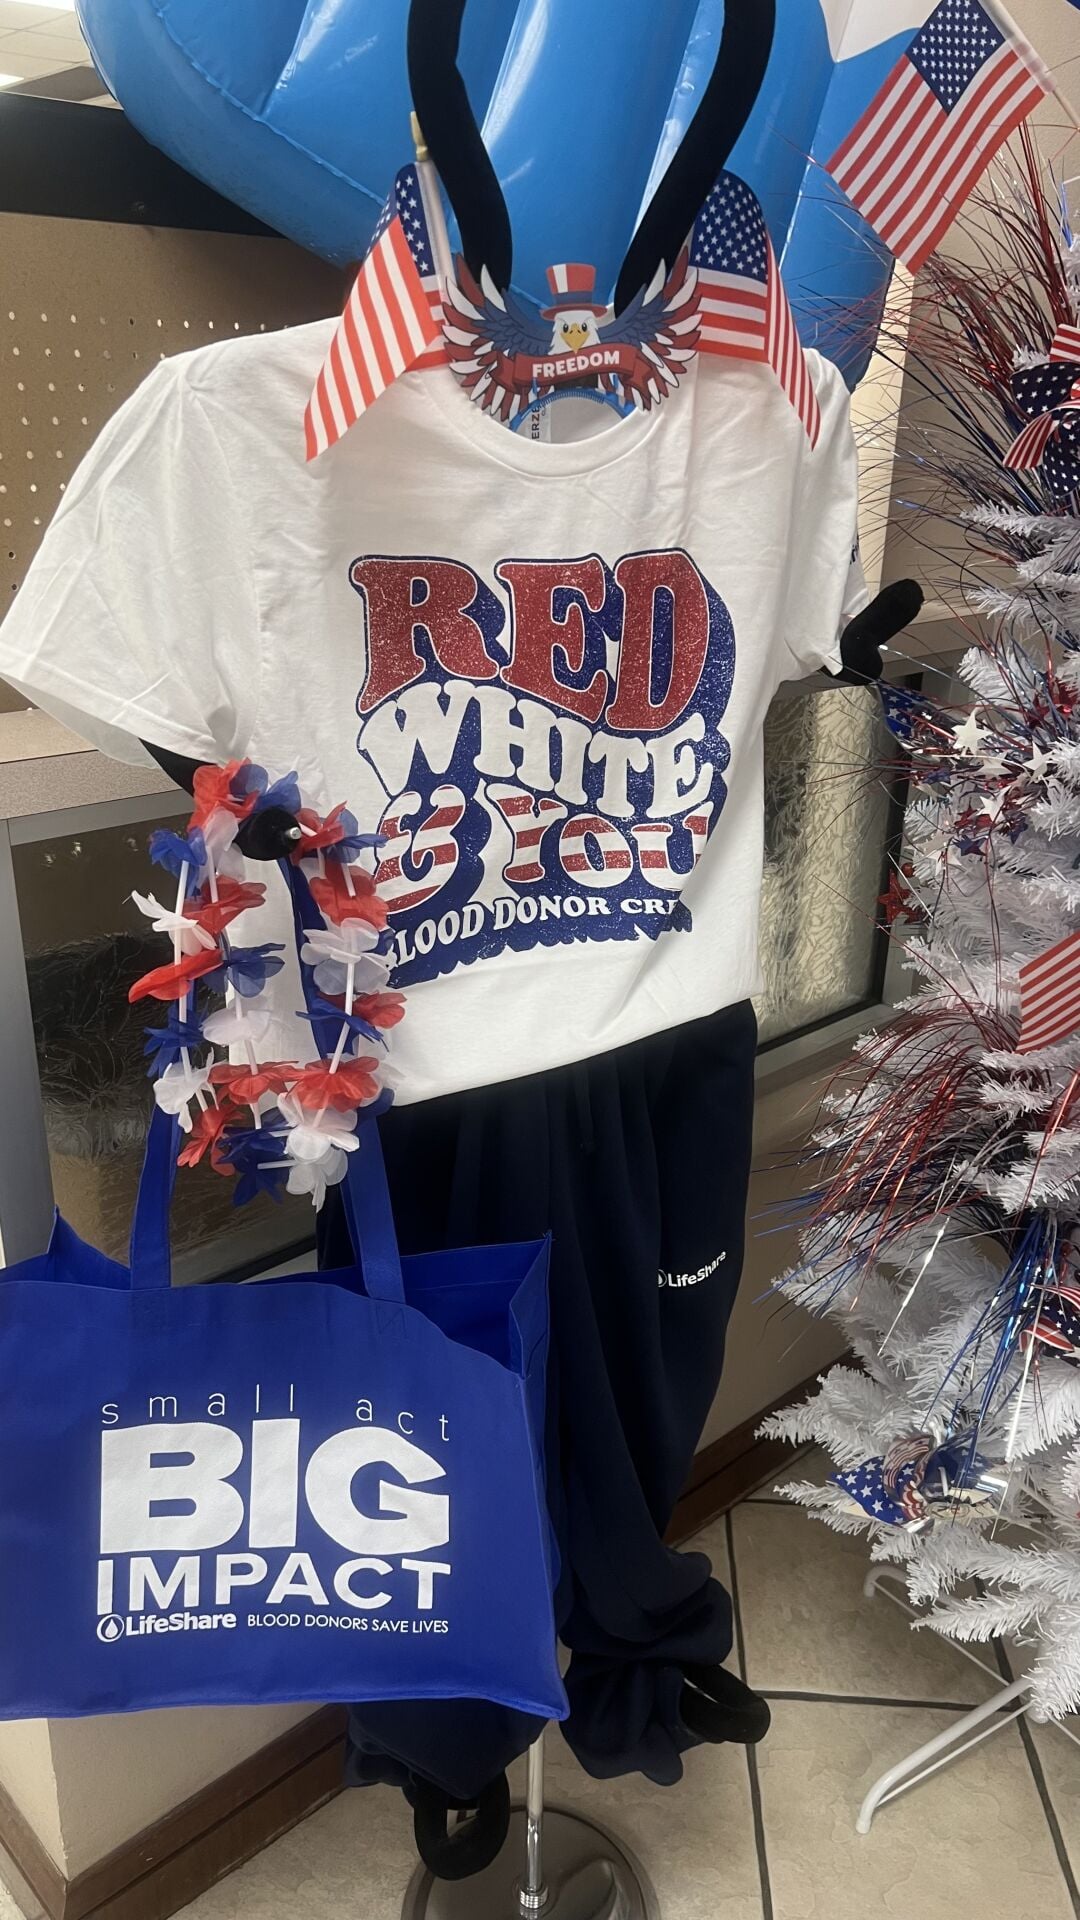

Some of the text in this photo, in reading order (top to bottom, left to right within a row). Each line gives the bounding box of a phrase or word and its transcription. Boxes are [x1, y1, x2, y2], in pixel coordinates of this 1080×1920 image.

[532, 350, 620, 378] FREEDOM
[349, 548, 714, 731] RED
[358, 680, 714, 819] WHITE
[374, 782, 713, 912] & YOU
[493, 895, 611, 931] DONOR
[667, 1251, 726, 1287] LifeShare
[101, 1383, 450, 1442] small act
[100, 1418, 450, 1555] BIG
[96, 1553, 451, 1616] IMPACT
[126, 1612, 449, 1637] LifeShare BLOOD DONORS SAVE LIVES
